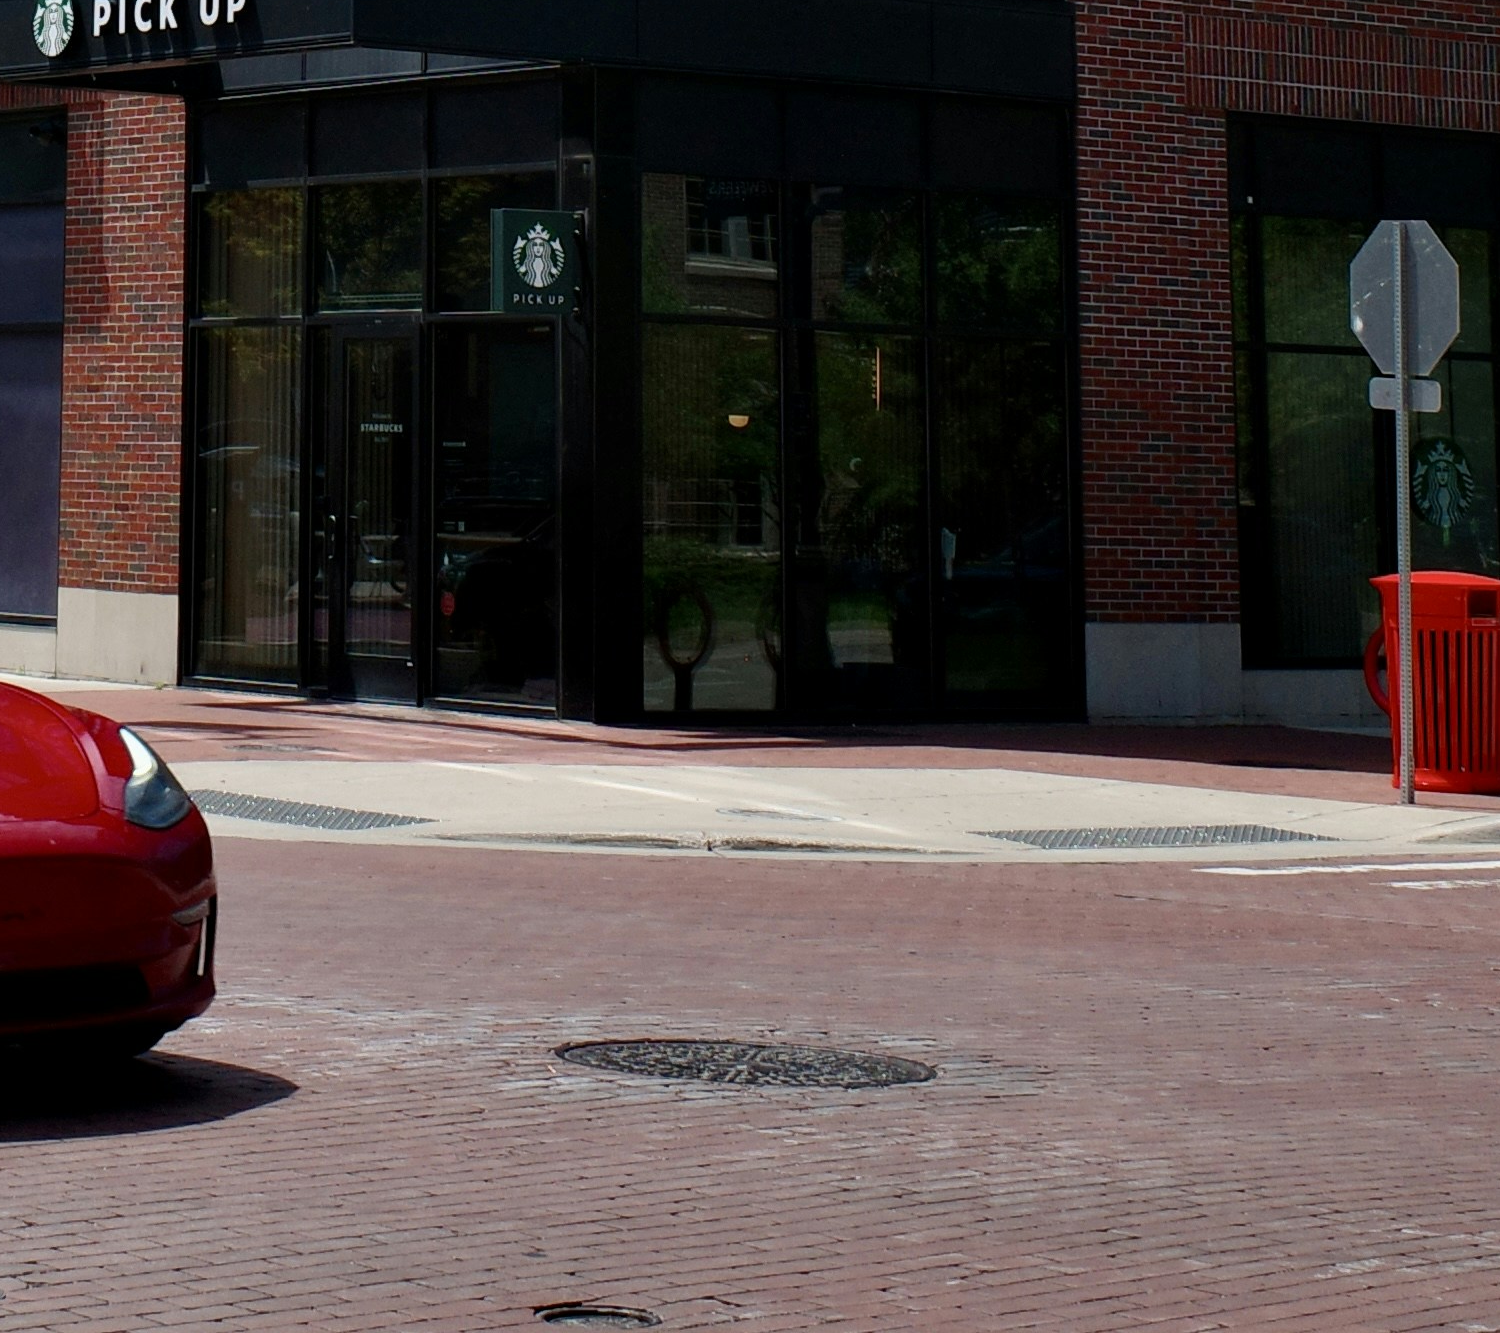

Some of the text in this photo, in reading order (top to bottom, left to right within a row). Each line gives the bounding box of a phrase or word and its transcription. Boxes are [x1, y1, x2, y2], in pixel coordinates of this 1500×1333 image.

[512, 292, 566, 306] PICK UP
[360, 423, 404, 433] STARBUCKS
